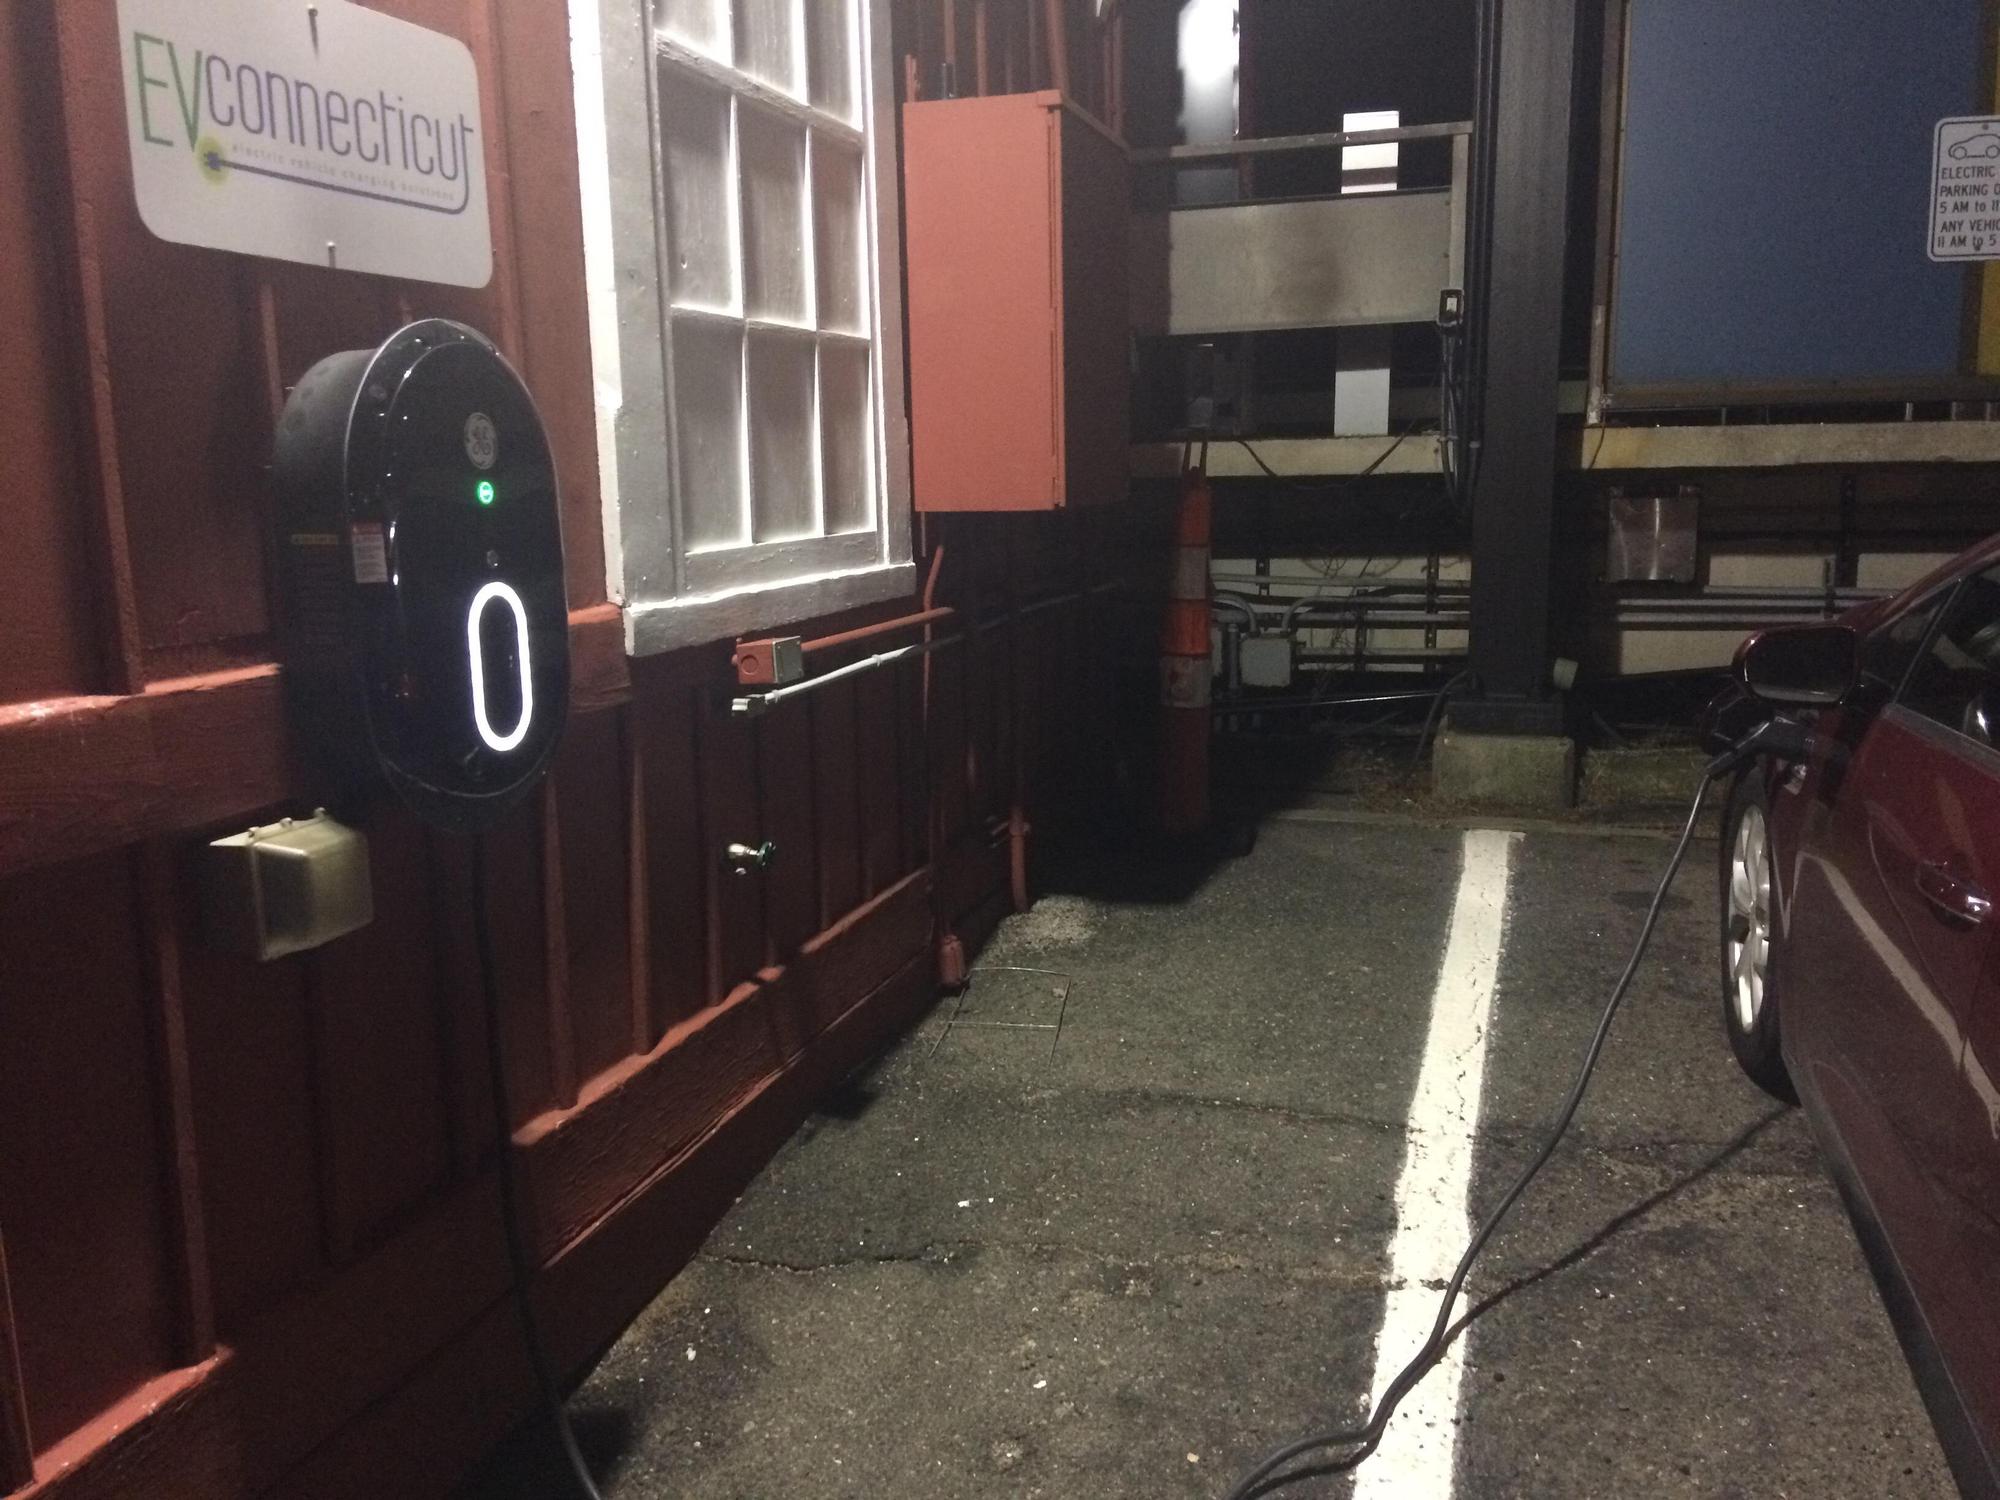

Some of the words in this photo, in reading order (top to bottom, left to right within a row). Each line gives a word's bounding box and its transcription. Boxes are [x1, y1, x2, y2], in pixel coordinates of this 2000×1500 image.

[1941, 165, 1995, 180] ELECTRIC
[1940, 183, 1989, 197] PARKING
[1939, 201, 1947, 214] 5
[1952, 200, 1969, 213] AM
[1975, 201, 1986, 213] to
[1940, 220, 1964, 233] ANY
[1950, 235, 1967, 248] AM
[1972, 235, 1984, 247] to
[1988, 233, 1997, 247] 5
